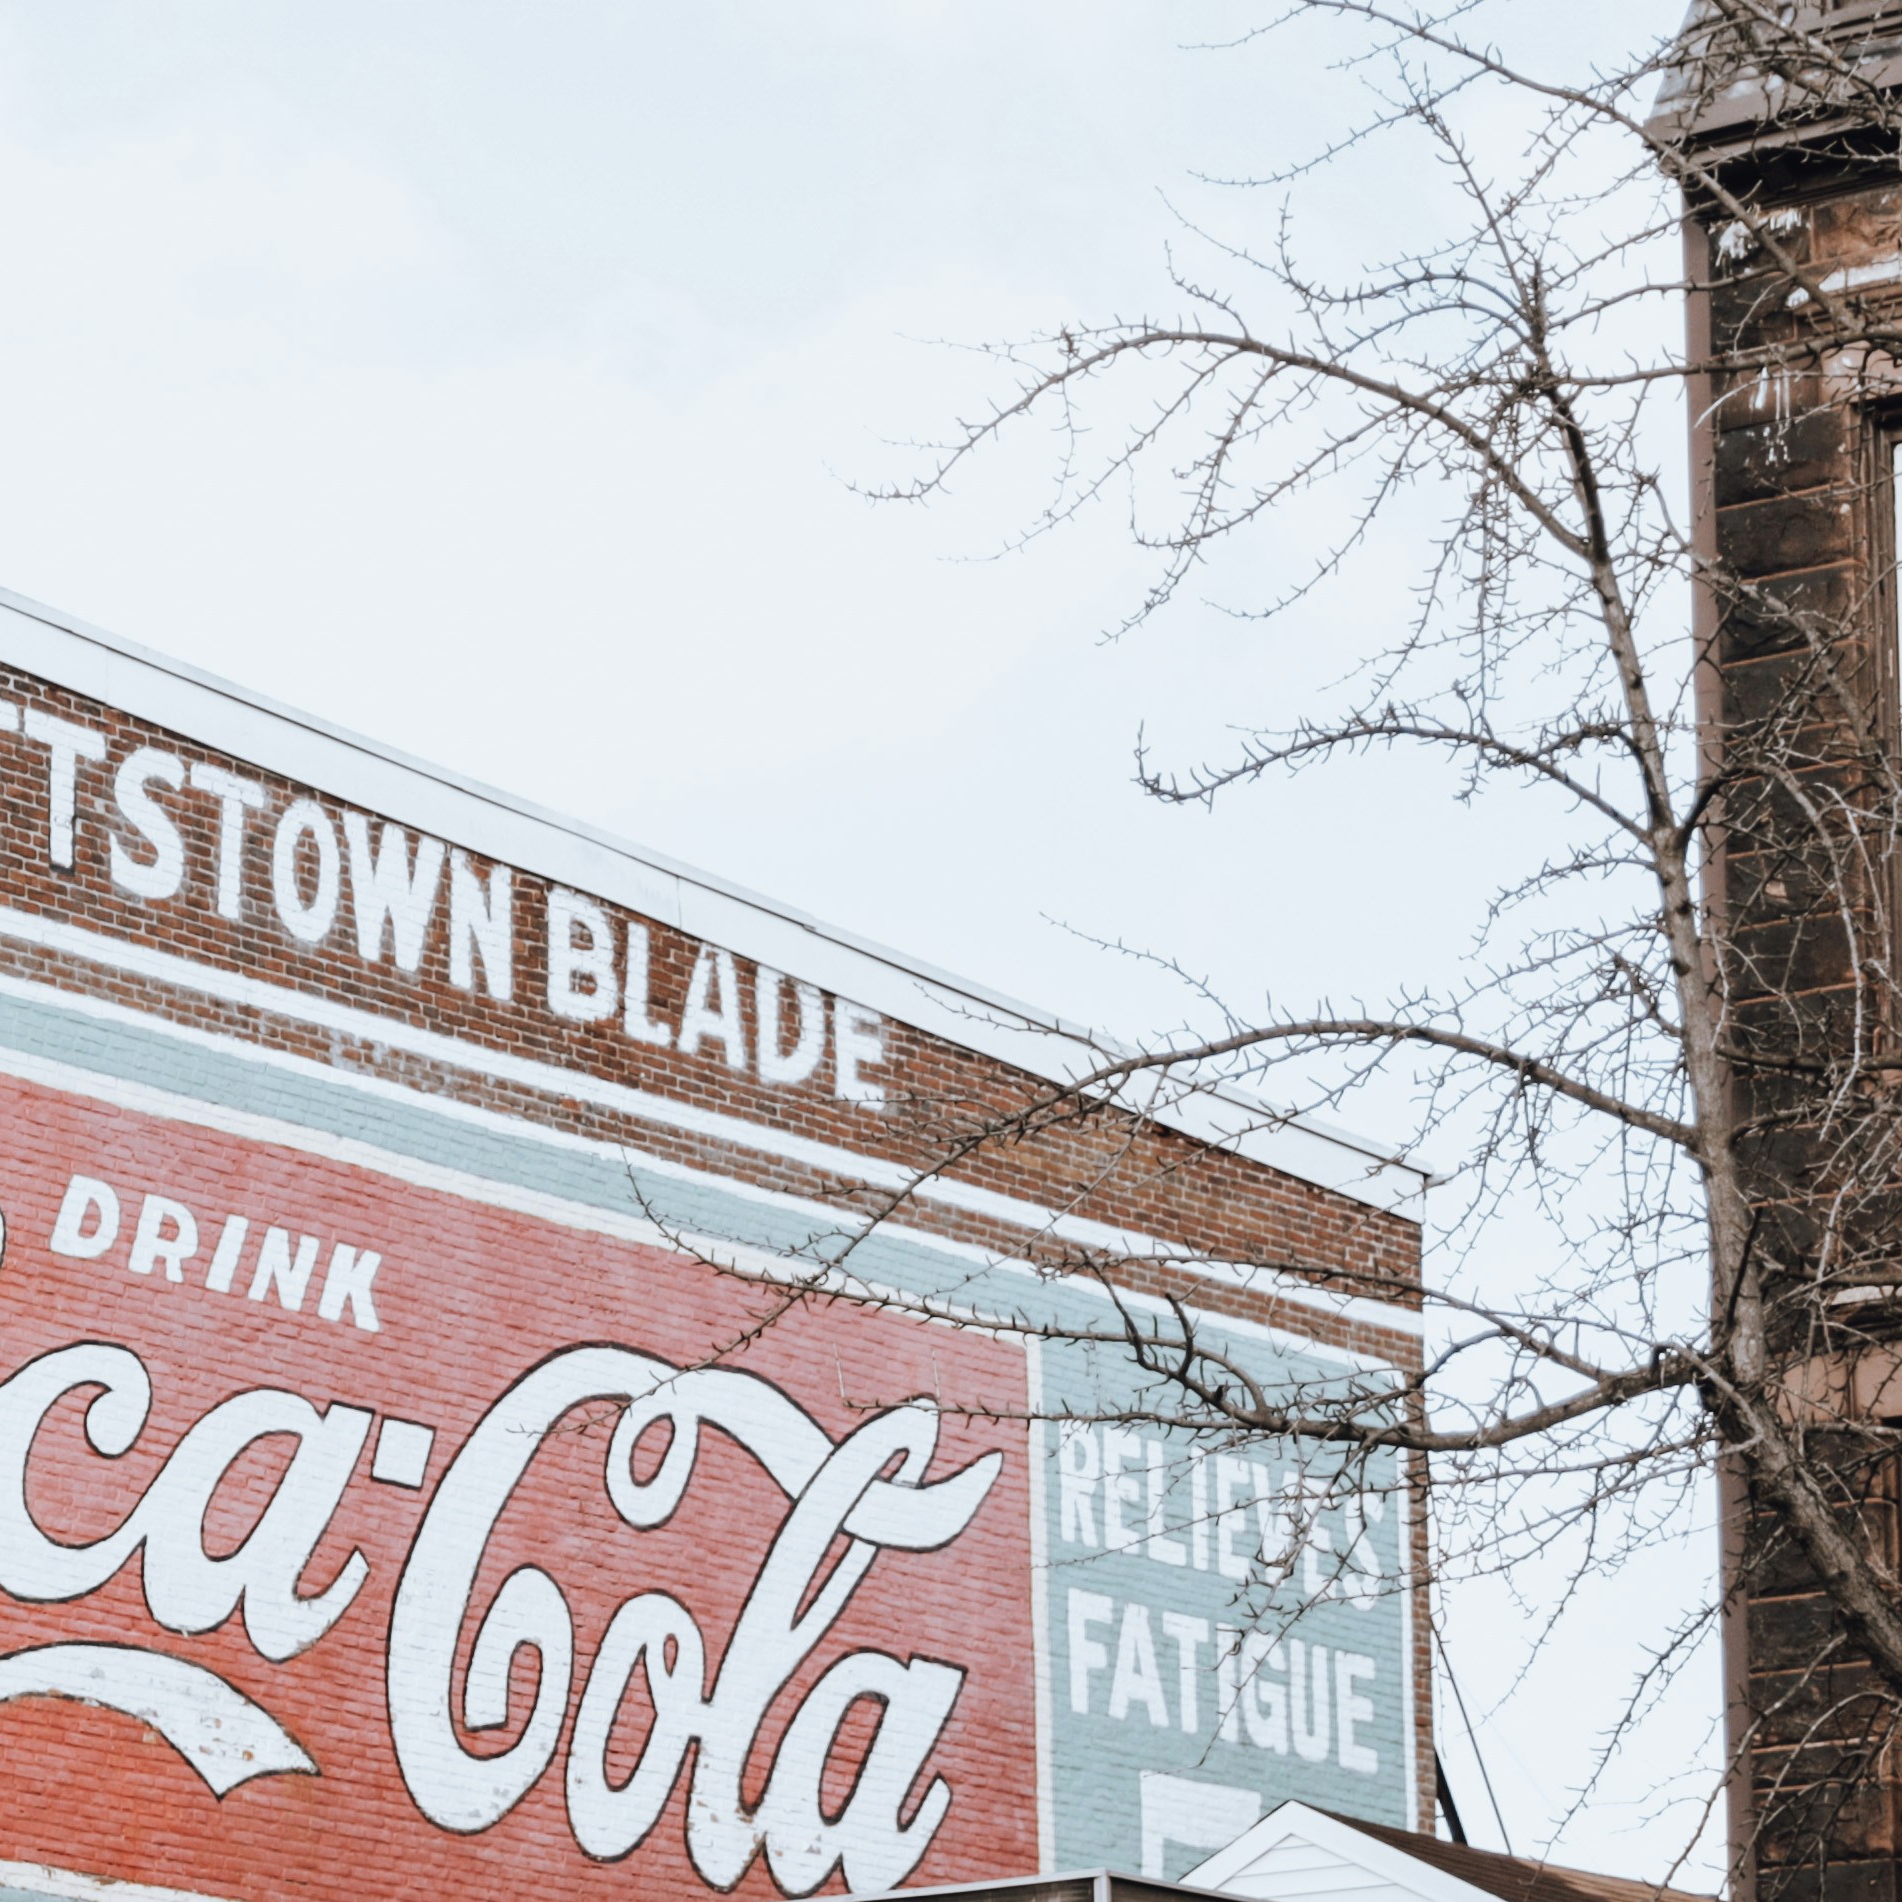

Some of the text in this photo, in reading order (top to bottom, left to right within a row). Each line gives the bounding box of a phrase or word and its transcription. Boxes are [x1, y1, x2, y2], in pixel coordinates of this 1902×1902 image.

[546, 882, 888, 1112] BLADE
[50, 1173, 382, 1334] DRINK
[1057, 1418, 1384, 1612] RELIEVES
[1068, 1588, 1379, 1775] FATIGUE
